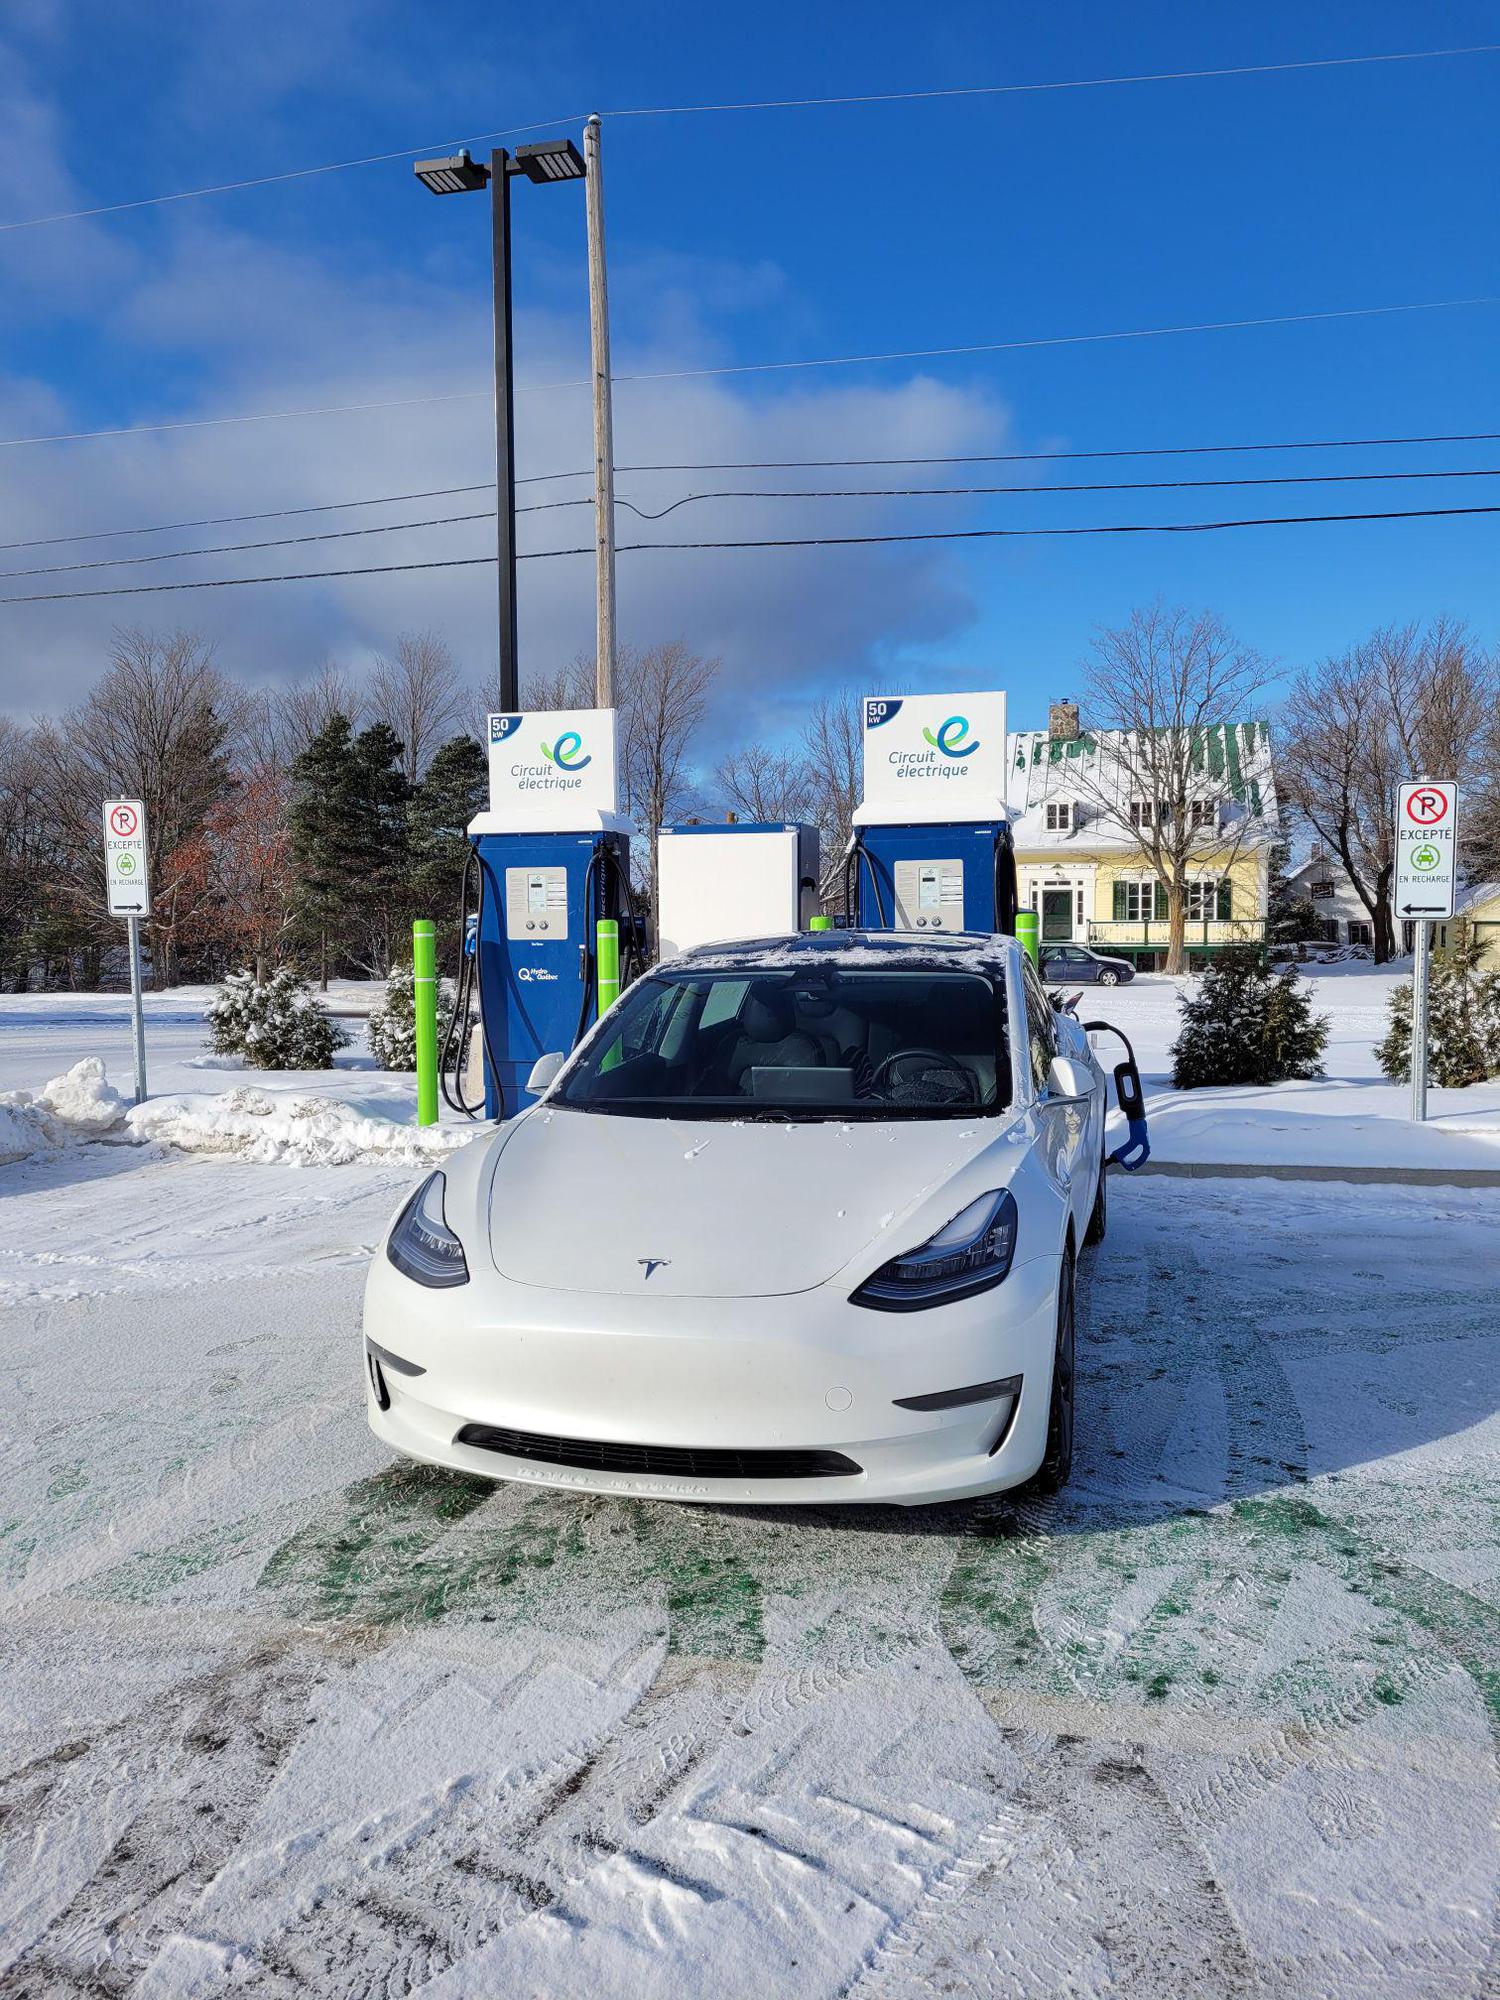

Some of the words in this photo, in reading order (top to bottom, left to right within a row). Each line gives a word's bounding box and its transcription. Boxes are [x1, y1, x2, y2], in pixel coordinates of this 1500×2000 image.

[868, 703, 887, 716] 50
[492, 719, 509, 731] 50
[868, 716, 881, 724] kW
[492, 731, 504, 739] kW
[888, 751, 936, 764] Circuit
[510, 763, 553, 776] Circuit
[896, 764, 969, 780] électrique
[518, 776, 582, 791] électrique
[1400, 827, 1452, 840] EXCEPTÉ
